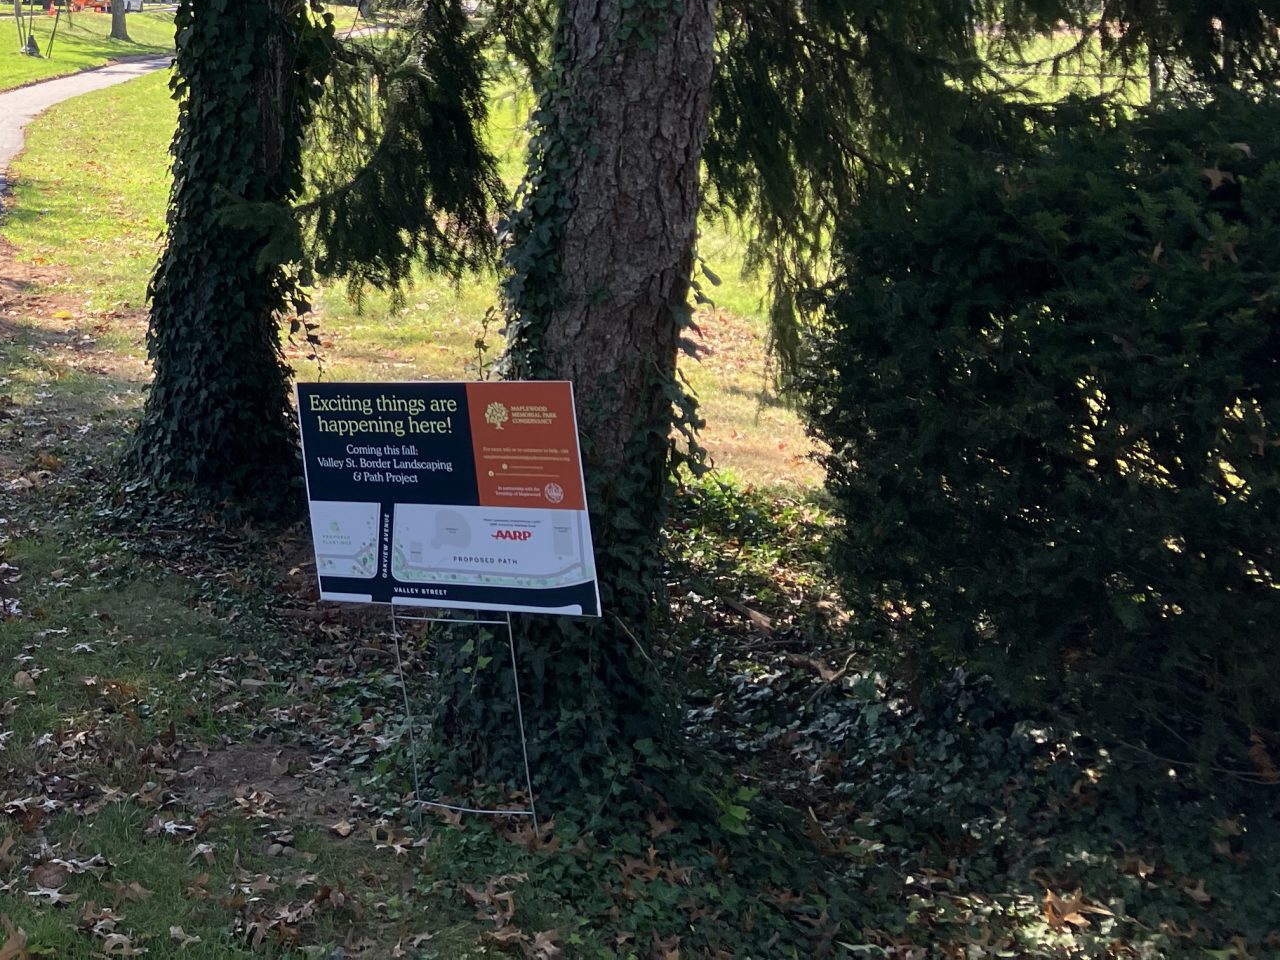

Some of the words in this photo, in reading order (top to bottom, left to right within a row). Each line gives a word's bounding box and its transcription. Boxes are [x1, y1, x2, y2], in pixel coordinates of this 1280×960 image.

[309, 394, 373, 415] Exciting
[375, 394, 426, 416] things
[430, 399, 457, 412] are
[318, 415, 406, 436] happening
[408, 416, 453, 434] here!
[346, 444, 382, 456] Coming
[383, 445, 400, 455] this
[401, 445, 419, 456] fall:
[317, 457, 344, 469] Valley
[345, 458, 358, 468] St.
[359, 458, 391, 469] Border
[393, 459, 453, 471] Landscaping
[353, 471, 361, 481] &
[364, 472, 384, 482] Path
[386, 472, 418, 484] Project
[491, 529, 532, 541] AARP
[453, 556, 495, 564] PROPOSED
[421, 588, 448, 596] STREET
